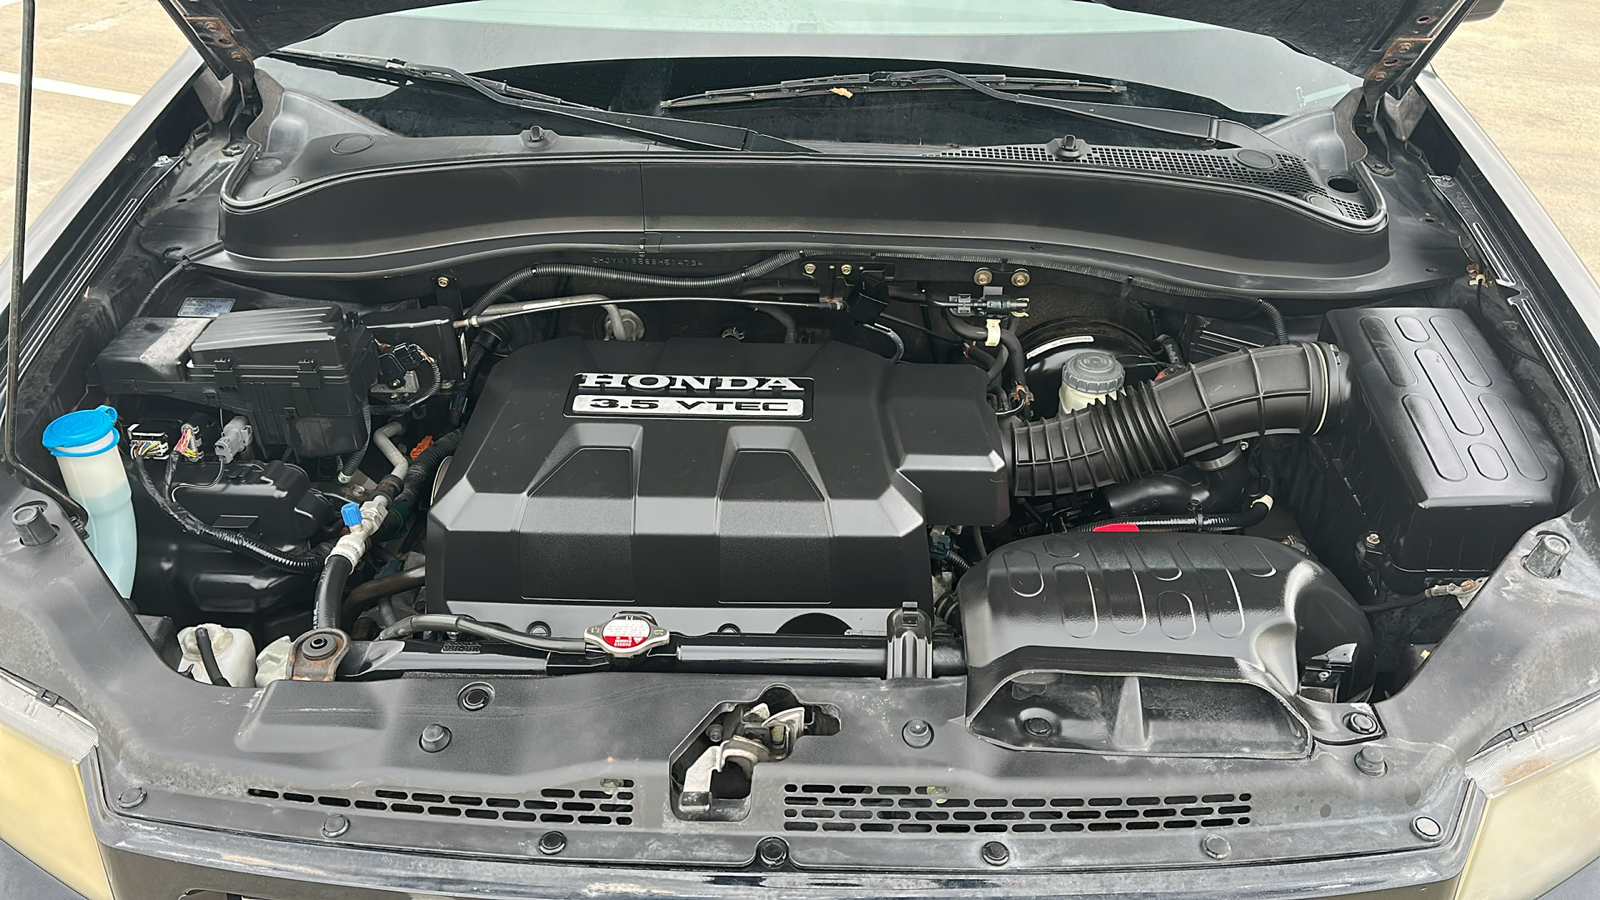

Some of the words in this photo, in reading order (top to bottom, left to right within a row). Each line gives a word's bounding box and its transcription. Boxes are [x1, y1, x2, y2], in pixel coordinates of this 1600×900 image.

[578, 372, 805, 392] HONDA
[589, 398, 660, 410] 3.5
[676, 400, 789, 412] VTEC
